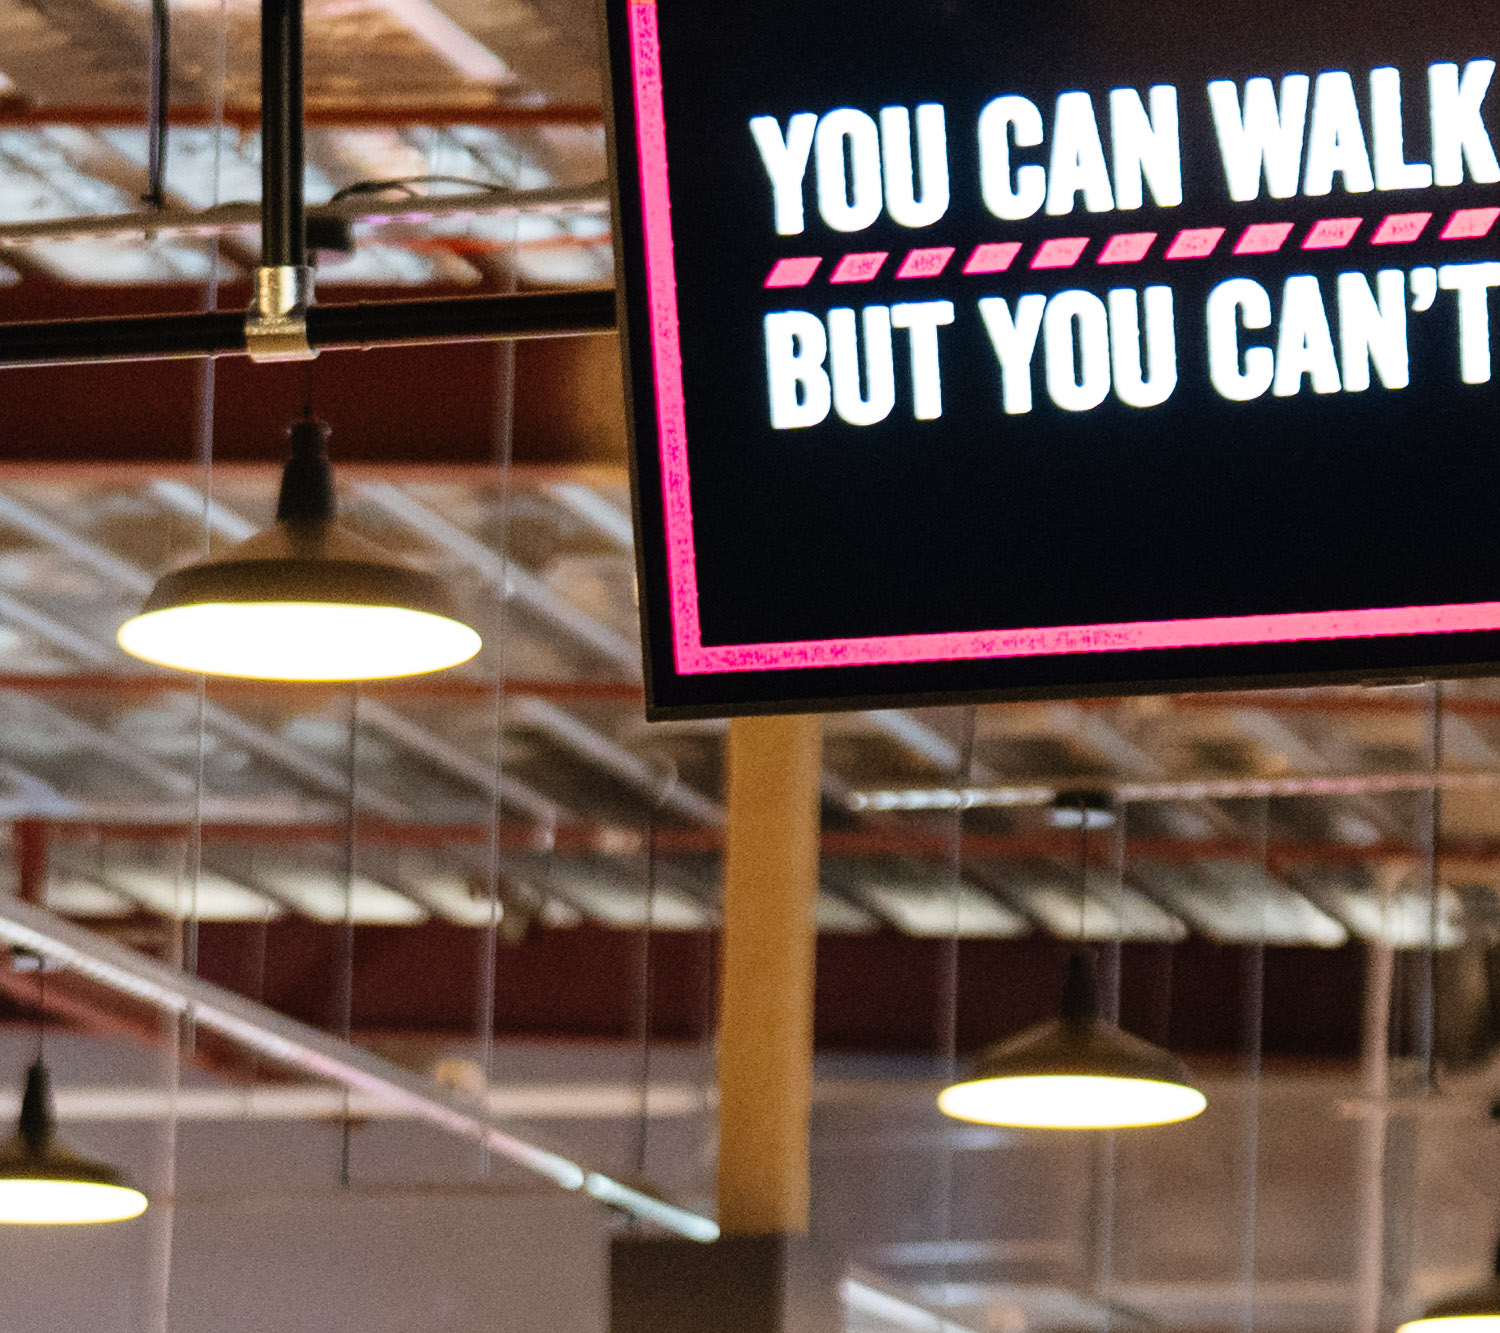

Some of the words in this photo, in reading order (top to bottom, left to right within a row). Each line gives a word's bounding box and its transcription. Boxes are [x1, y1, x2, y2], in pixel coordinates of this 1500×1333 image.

[749, 103, 951, 236] YOU
[977, 84, 1183, 221] CAN
[764, 300, 956, 430] BUT
[978, 285, 1178, 415] YOU
